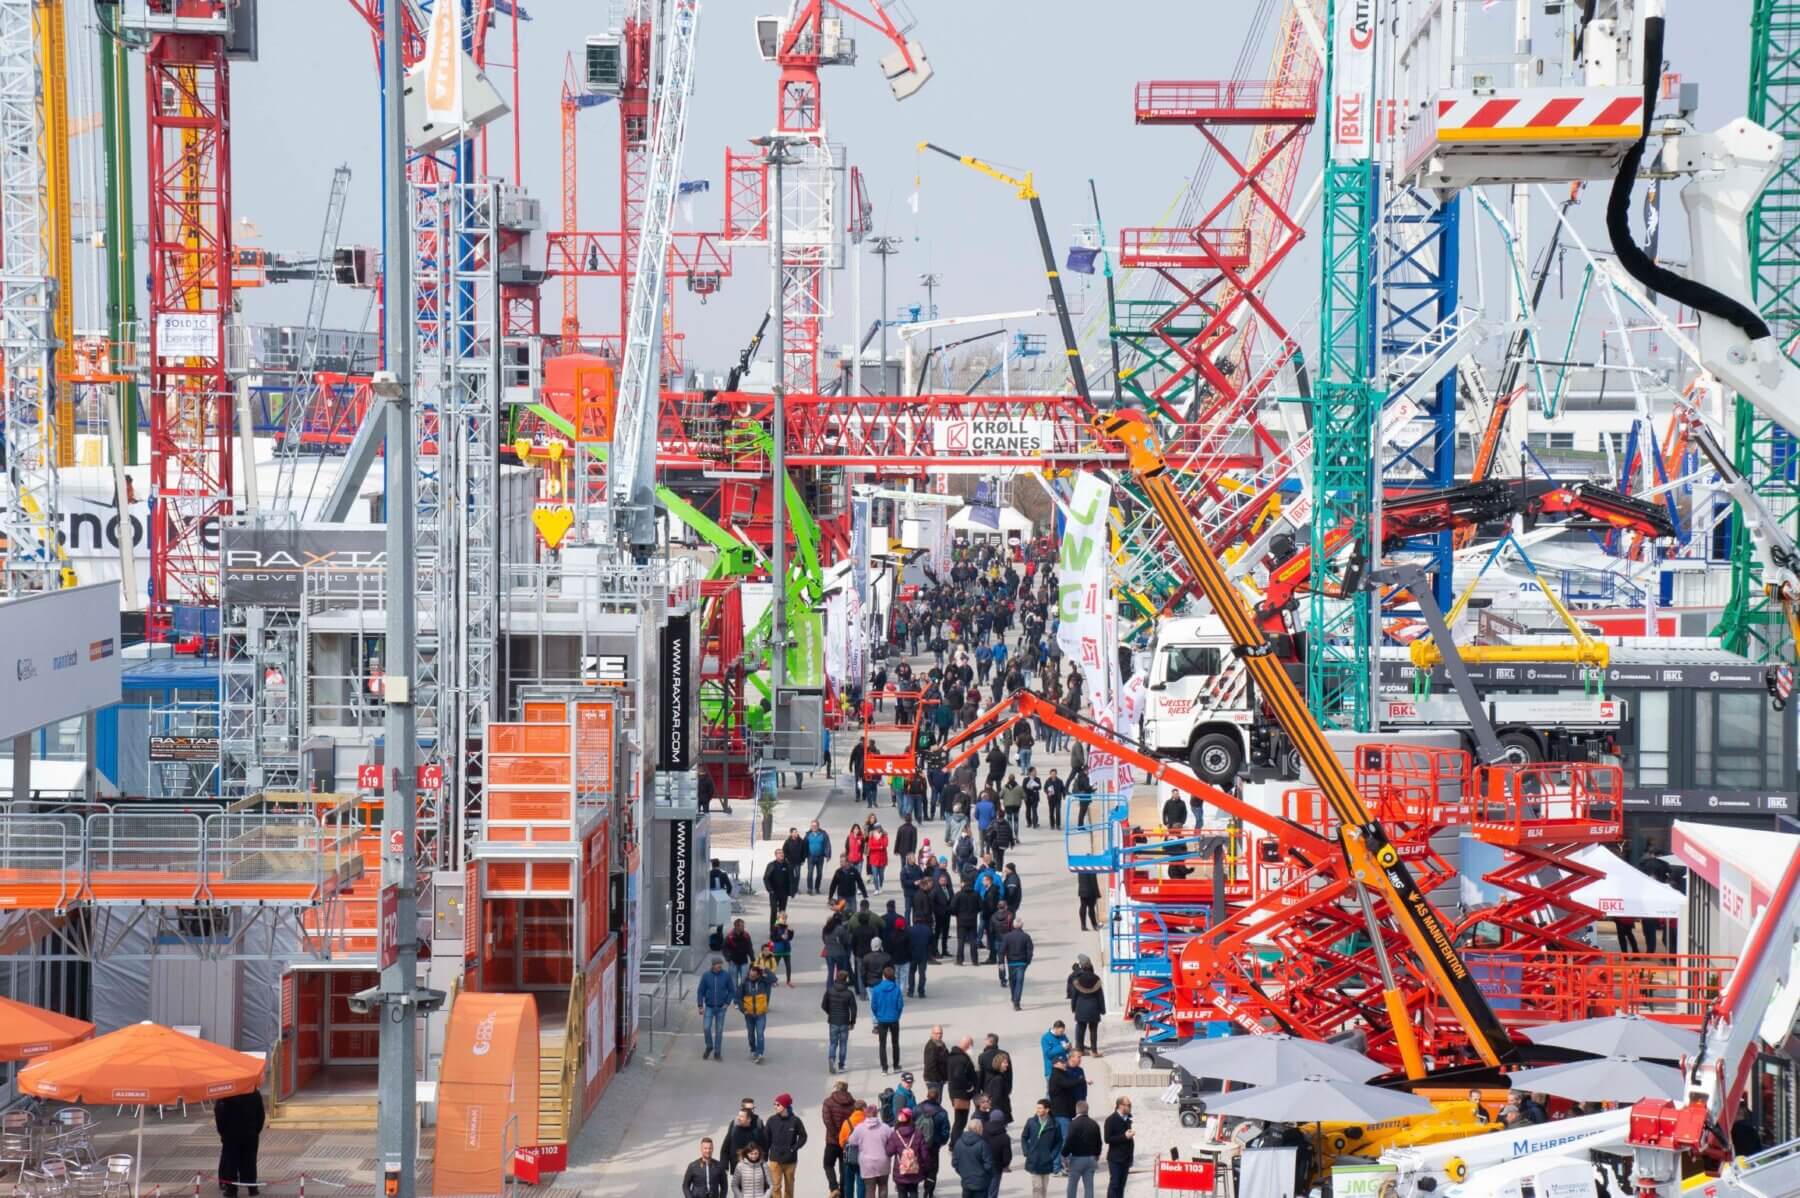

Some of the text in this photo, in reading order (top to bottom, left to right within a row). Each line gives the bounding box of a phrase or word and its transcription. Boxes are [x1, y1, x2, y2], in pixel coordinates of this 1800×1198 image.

[165, 319, 191, 328] SOLD
[972, 421, 1029, 434] KRØLL
[972, 436, 1041, 450] CRANES
[671, 638, 681, 763] WWW.RAXTAR.COM
[1389, 703, 1416, 717] BKL
[361, 776, 379, 788] 119
[422, 776, 439, 788] 119
[676, 820, 687, 945] WWW.RAXTAR.COM
[1386, 868, 1405, 889] JMG
[1600, 899, 1625, 911] BKL
[384, 912, 398, 947] F12
[1414, 902, 1467, 979] AS MANUTENTION
[1213, 996, 1237, 1016] ELS
[1195, 1010, 1213, 1018] LIFT
[541, 1145, 559, 1155] 1102
[1160, 1162, 1204, 1173] Block 1103
